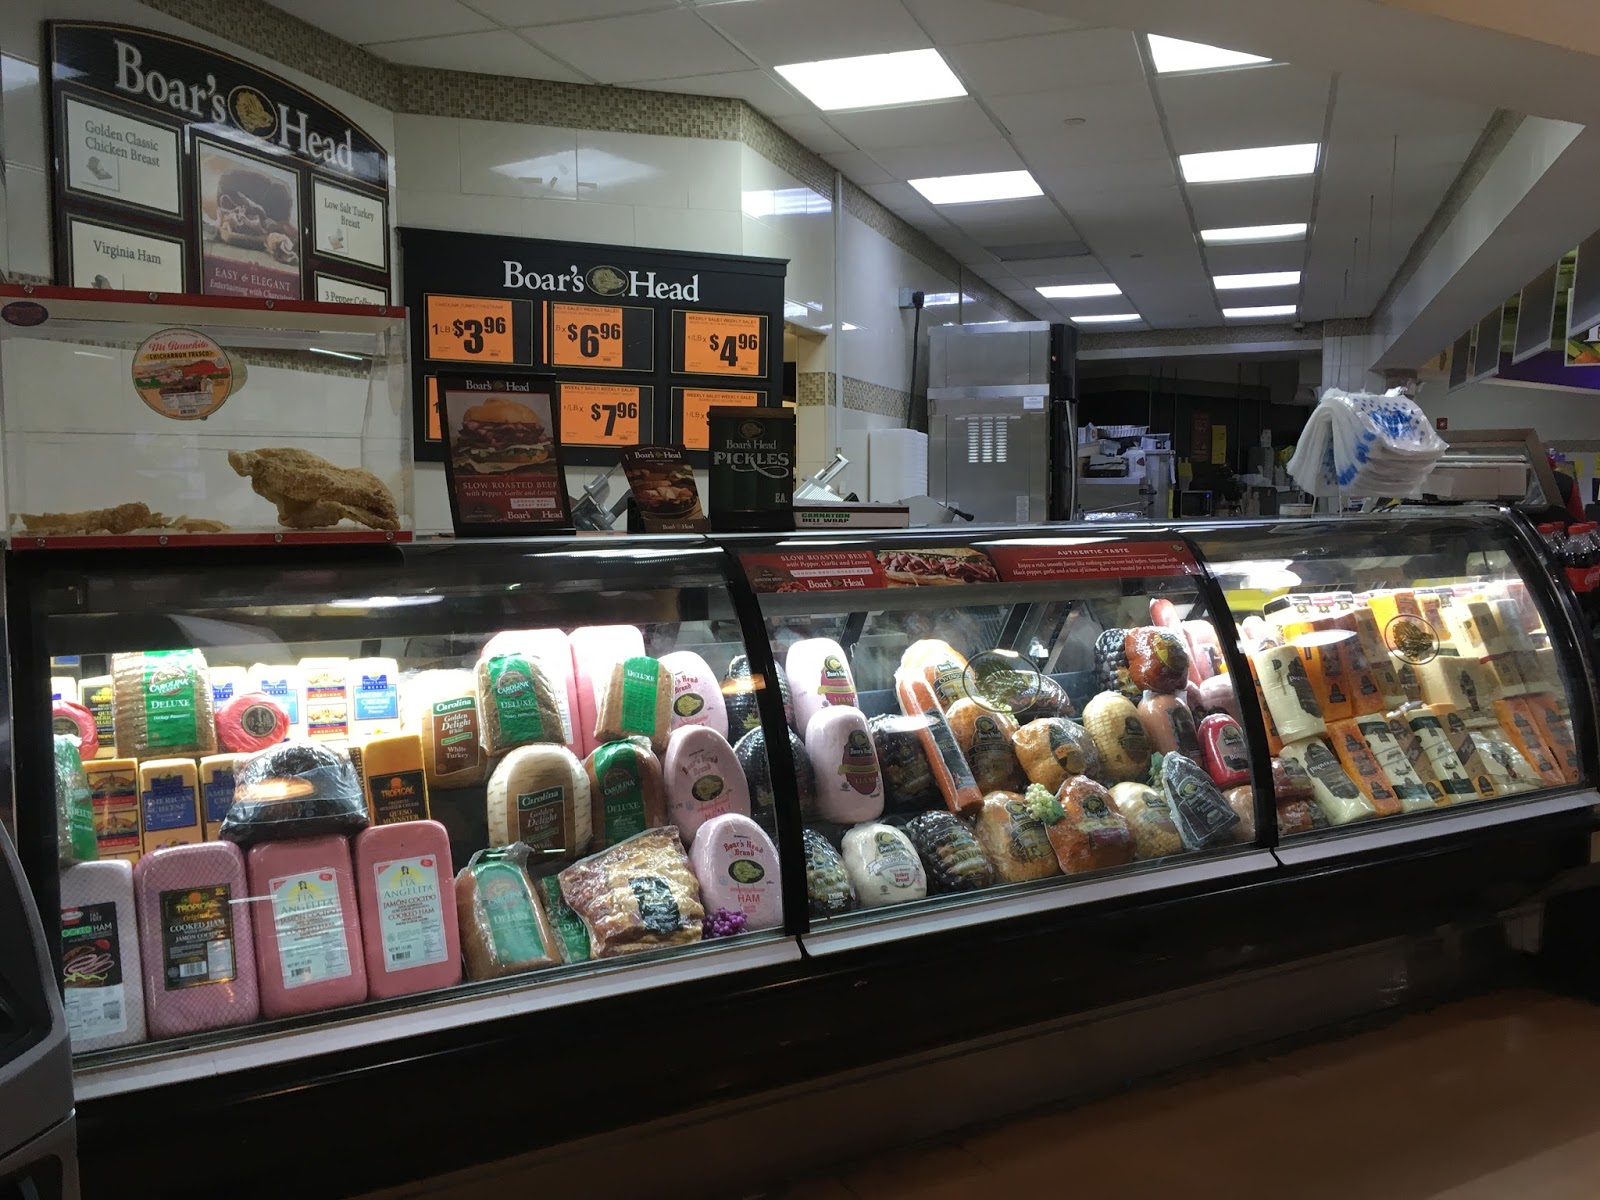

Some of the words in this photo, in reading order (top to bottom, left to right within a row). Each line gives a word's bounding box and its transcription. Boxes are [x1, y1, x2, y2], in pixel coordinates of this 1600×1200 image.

[113, 39, 227, 124] Boar's
[277, 103, 354, 172] Head
[85, 120, 123, 141] Golden
[125, 131, 159, 151] Classic
[85, 136, 128, 159] Chicken
[131, 148, 160, 167] Breast
[324, 198, 338, 211] Low
[340, 201, 351, 214] Salt
[351, 205, 374, 222] Turkey
[341, 215, 360, 230] Breast
[93, 240, 135, 260] Virginia
[137, 249, 161, 264] Ham
[215, 267, 238, 281] EASY
[241, 273, 249, 281] &
[251, 275, 291, 291] ELEGANT
[502, 260, 584, 293] Boar's
[628, 270, 700, 302] Head
[325, 291, 330, 300] 3
[432, 323, 438, 335] 1
[440, 325, 451, 333] LB
[149, 342, 166, 351] Mi
[167, 339, 209, 350] Ranchito
[150, 351, 187, 360] CHICHARRON
[188, 350, 209, 358] FRESCO
[465, 380, 492, 391] Boar's
[506, 381, 530, 392] Head
[726, 439, 752, 449] Boar's
[753, 439, 776, 449] Head
[635, 451, 654, 459] Boar's
[663, 451, 682, 459] Head
[713, 451, 790, 473] PICKLES
[536, 481, 558, 489] BEEF
[775, 493, 788, 503] EA.
[507, 511, 531, 519] Boar's
[542, 510, 563, 519] Head
[807, 579, 832, 588] Boar's
[841, 578, 865, 587] Head
[627, 669, 655, 682] DELUXE
[149, 678, 189, 693] CAROLINA
[497, 681, 530, 695] CAROLINA
[151, 699, 190, 709] DELUXE
[436, 699, 472, 712] Carolina
[501, 700, 534, 709] DELUXE
[444, 713, 468, 722] Golden
[441, 719, 471, 731] Delight
[381, 786, 415, 798] TROPICAL
[604, 779, 636, 796] CAROLINA
[522, 791, 559, 807] Carolina
[530, 807, 554, 819] Golden
[607, 801, 640, 813] DELUXE
[527, 813, 558, 828] Delight
[723, 839, 745, 852] Boar's
[734, 848, 755, 857] Brand
[384, 884, 433, 899] ANGELITA
[408, 894, 436, 904] COCIDO
[737, 894, 760, 903] HAM
[281, 899, 334, 914] ANGELITA
[183, 909, 211, 922] Original
[388, 909, 418, 921] COOKED
[419, 907, 435, 915] HAM
[61, 926, 93, 938] OOKED
[93, 922, 112, 932] HAM
[170, 922, 205, 933] COOKED
[206, 918, 226, 928] HAM
